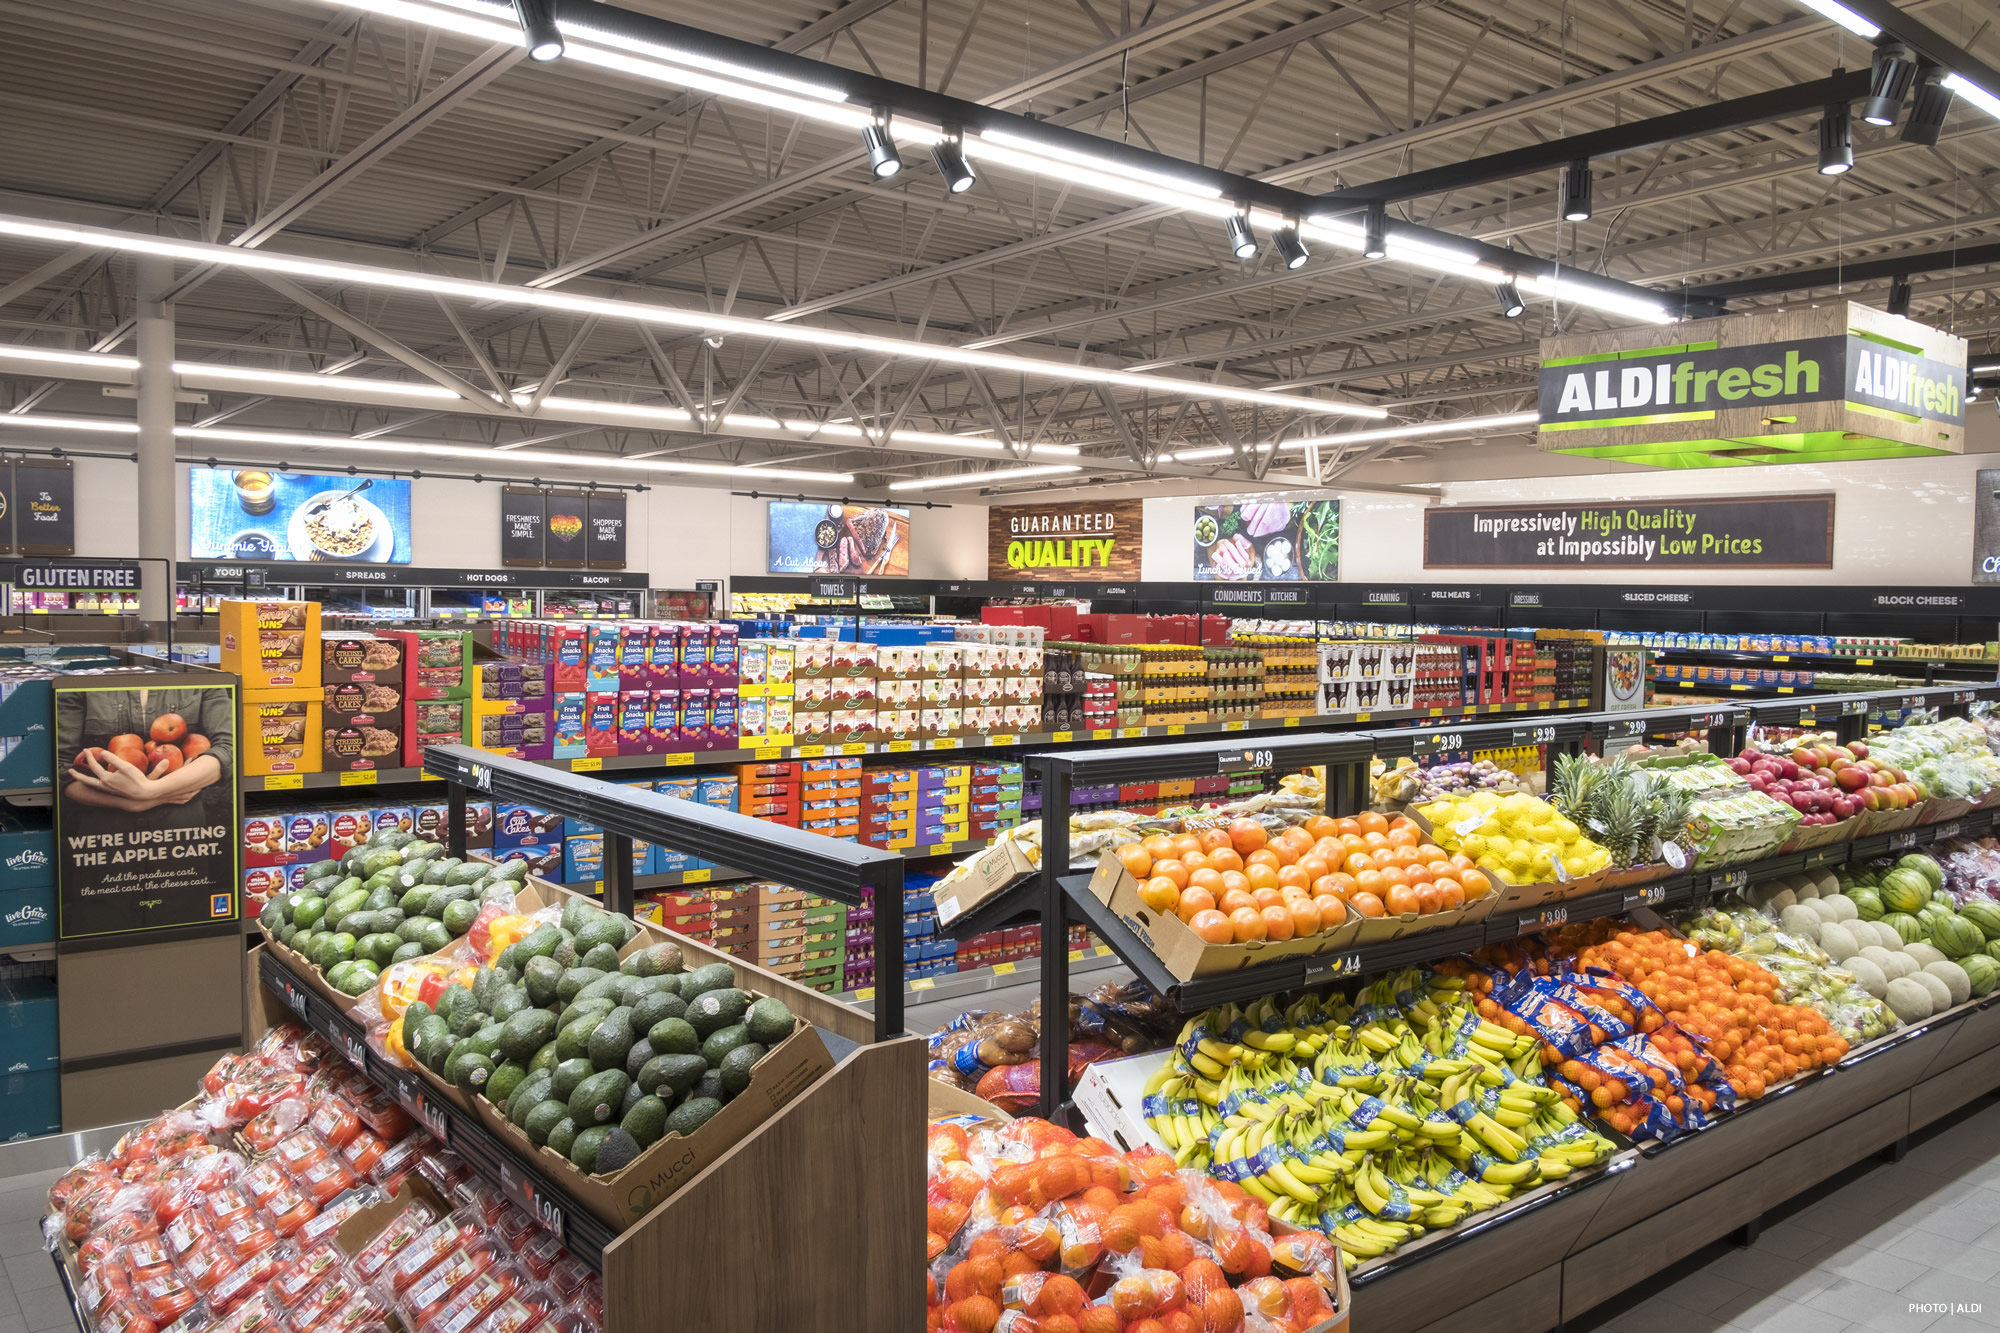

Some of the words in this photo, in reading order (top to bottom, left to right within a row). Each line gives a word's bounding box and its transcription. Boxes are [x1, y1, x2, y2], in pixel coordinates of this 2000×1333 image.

[1557, 350, 1820, 414] ALDIfresh
[1854, 348, 1959, 417] ALDIfresh
[30, 502, 61, 512] Better
[34, 512, 58, 521] Food
[506, 515, 540, 524] FRESHNESS
[514, 523, 532, 531] MADE
[593, 519, 622, 527] SHOPPERS
[1011, 513, 1114, 533] GUARANTEED
[1474, 512, 1577, 538] Impressively
[1581, 510, 1622, 537] High
[1626, 508, 1697, 534] Quality
[511, 530, 535, 539] SIMPLE.
[599, 526, 616, 534] MADE
[597, 534, 618, 542] HAPPY.
[200, 537, 256, 554] Yummie
[1537, 538, 1555, 556] at
[1559, 535, 1656, 562] Impossibly
[1660, 535, 1697, 555] Low
[1701, 533, 1763, 555] Prices
[1007, 539, 1116, 570] QUALITY
[774, 557, 784, 567] A
[785, 556, 800, 567] Cut
[801, 557, 828, 568] Above
[1198, 564, 1222, 575] Lunch
[23, 568, 90, 586] GLUTEN
[93, 569, 135, 587] FREE
[346, 571, 387, 580] SPREADS
[467, 574, 483, 582] HOT
[485, 574, 508, 583] DOGS
[583, 576, 610, 584] BACON
[820, 584, 844, 596] TOWELS
[1432, 591, 1447, 599] DELI
[1448, 591, 1470, 599] MEATS
[1214, 590, 1262, 603] CONDIMENTS
[1270, 591, 1298, 601] KITCHEN
[1369, 592, 1400, 602] CLEANING
[1514, 594, 1539, 604] DRESSINGS
[1624, 593, 1654, 602] SLICED
[1657, 593, 1690, 602] CHEESE
[1878, 595, 1914, 605] BLOCK
[1916, 596, 1958, 606] CHEESE
[262, 649, 283, 658] UNS
[338, 700, 361, 709] CAKES
[263, 736, 284, 744] UNS
[338, 745, 361, 753] CAKES
[510, 815, 528, 826] Cup
[505, 824, 531, 835] Cakes
[68, 832, 124, 850] WE'RE
[128, 825, 227, 847] UPSETTING
[73, 852, 107, 867] THE
[112, 847, 168, 865] APPLE
[172, 842, 223, 858] CART.
[101, 872, 123, 885] And
[124, 871, 138, 882] the
[139, 869, 173, 884] produce
[174, 867, 198, 879] cart,
[81, 885, 96, 897] the
[97, 884, 121, 895] meat
[121, 882, 144, 894] cart,
[145, 880, 160, 891] the
[161, 879, 192, 889] cheese
[1123, 914, 1142, 934] HEARTY
[1140, 928, 1155, 949] FRESH
[649, 1147, 697, 1192] Mucci
